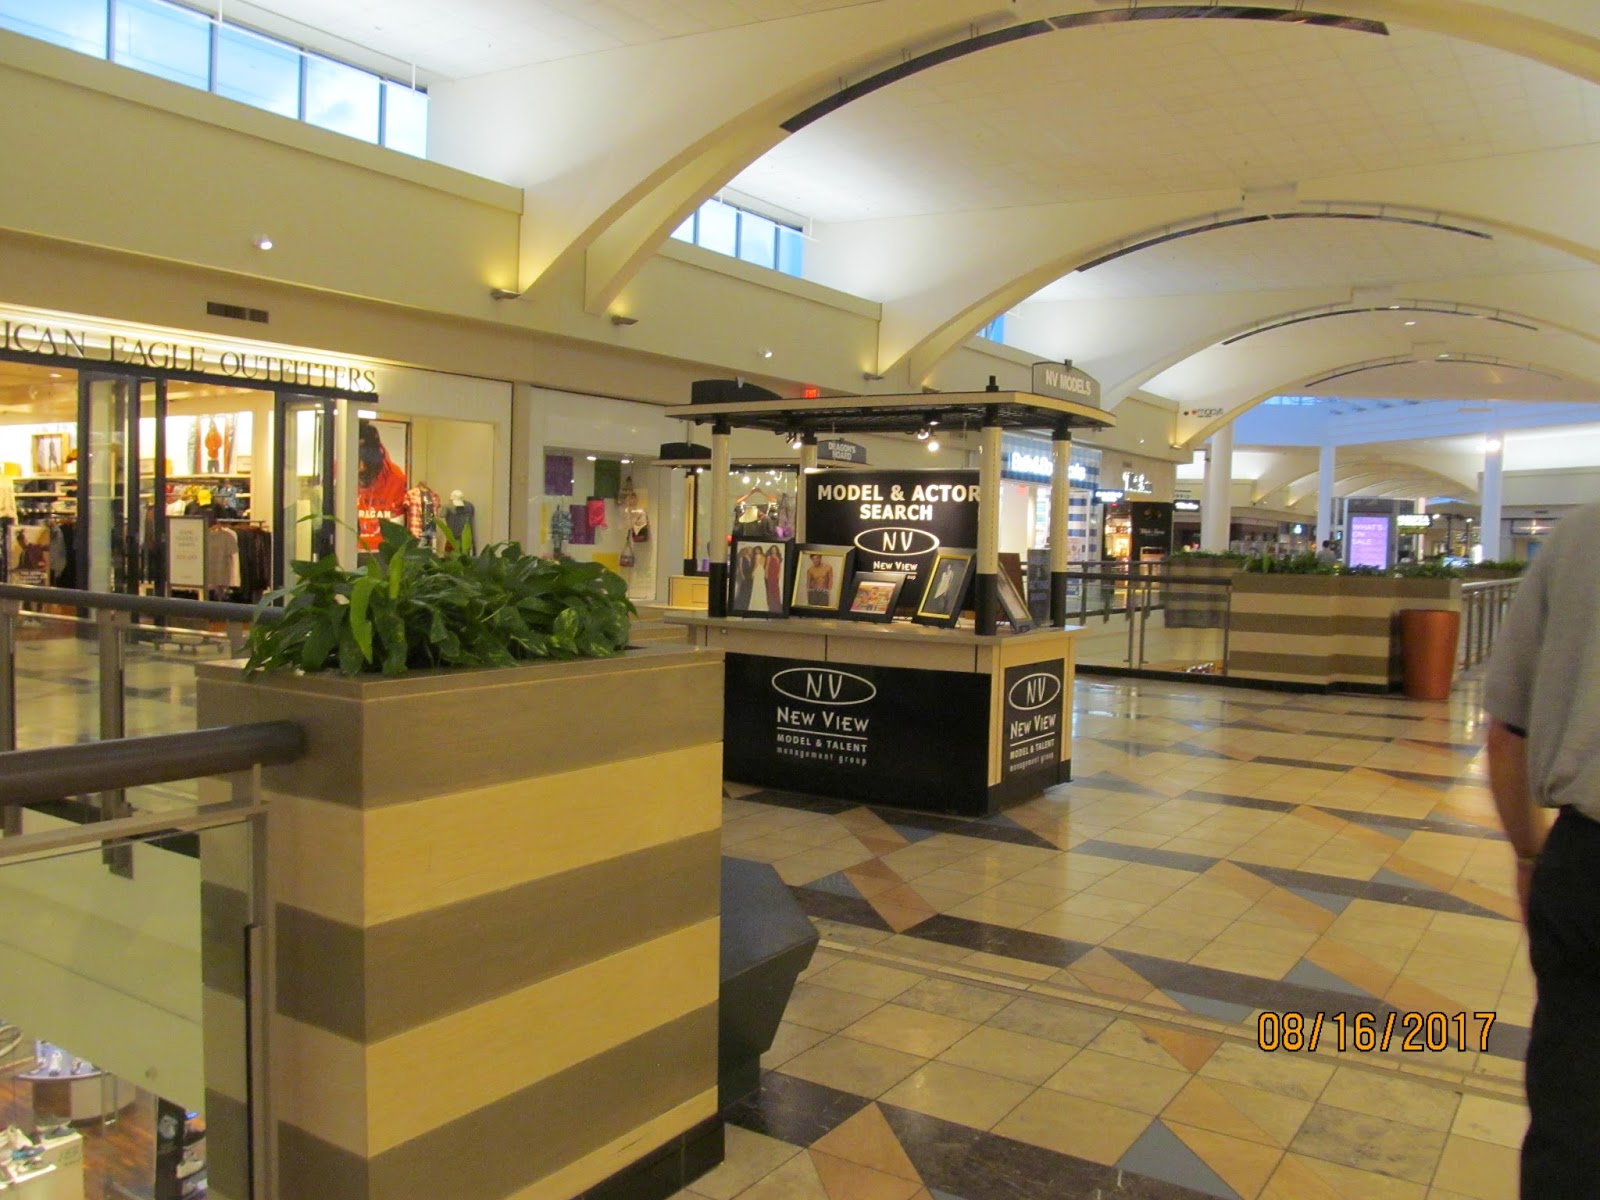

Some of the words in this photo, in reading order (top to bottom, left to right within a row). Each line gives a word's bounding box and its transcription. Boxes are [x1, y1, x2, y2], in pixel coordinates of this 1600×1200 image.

[110, 335, 206, 374] EAGLE
[220, 351, 376, 393] OUTFITTERS
[1045, 369, 1059, 387] NV
[1060, 373, 1092, 396] MODELS
[817, 484, 884, 501] MODEL
[890, 484, 905, 501] &
[912, 484, 981, 502] ACTOR
[859, 504, 933, 521] SEARCH
[882, 531, 914, 552] NV
[806, 673, 843, 700] NV
[1026, 677, 1046, 707] NV
[776, 734, 812, 746] MODEL
[816, 738, 823, 748] &
[826, 740, 868, 753] TALENT
[1010, 746, 1029, 760] MODEL
[1035, 738, 1055, 752] TALENT
[776, 747, 834, 759] management
[838, 755, 867, 767] group
[1009, 756, 1040, 773] management
